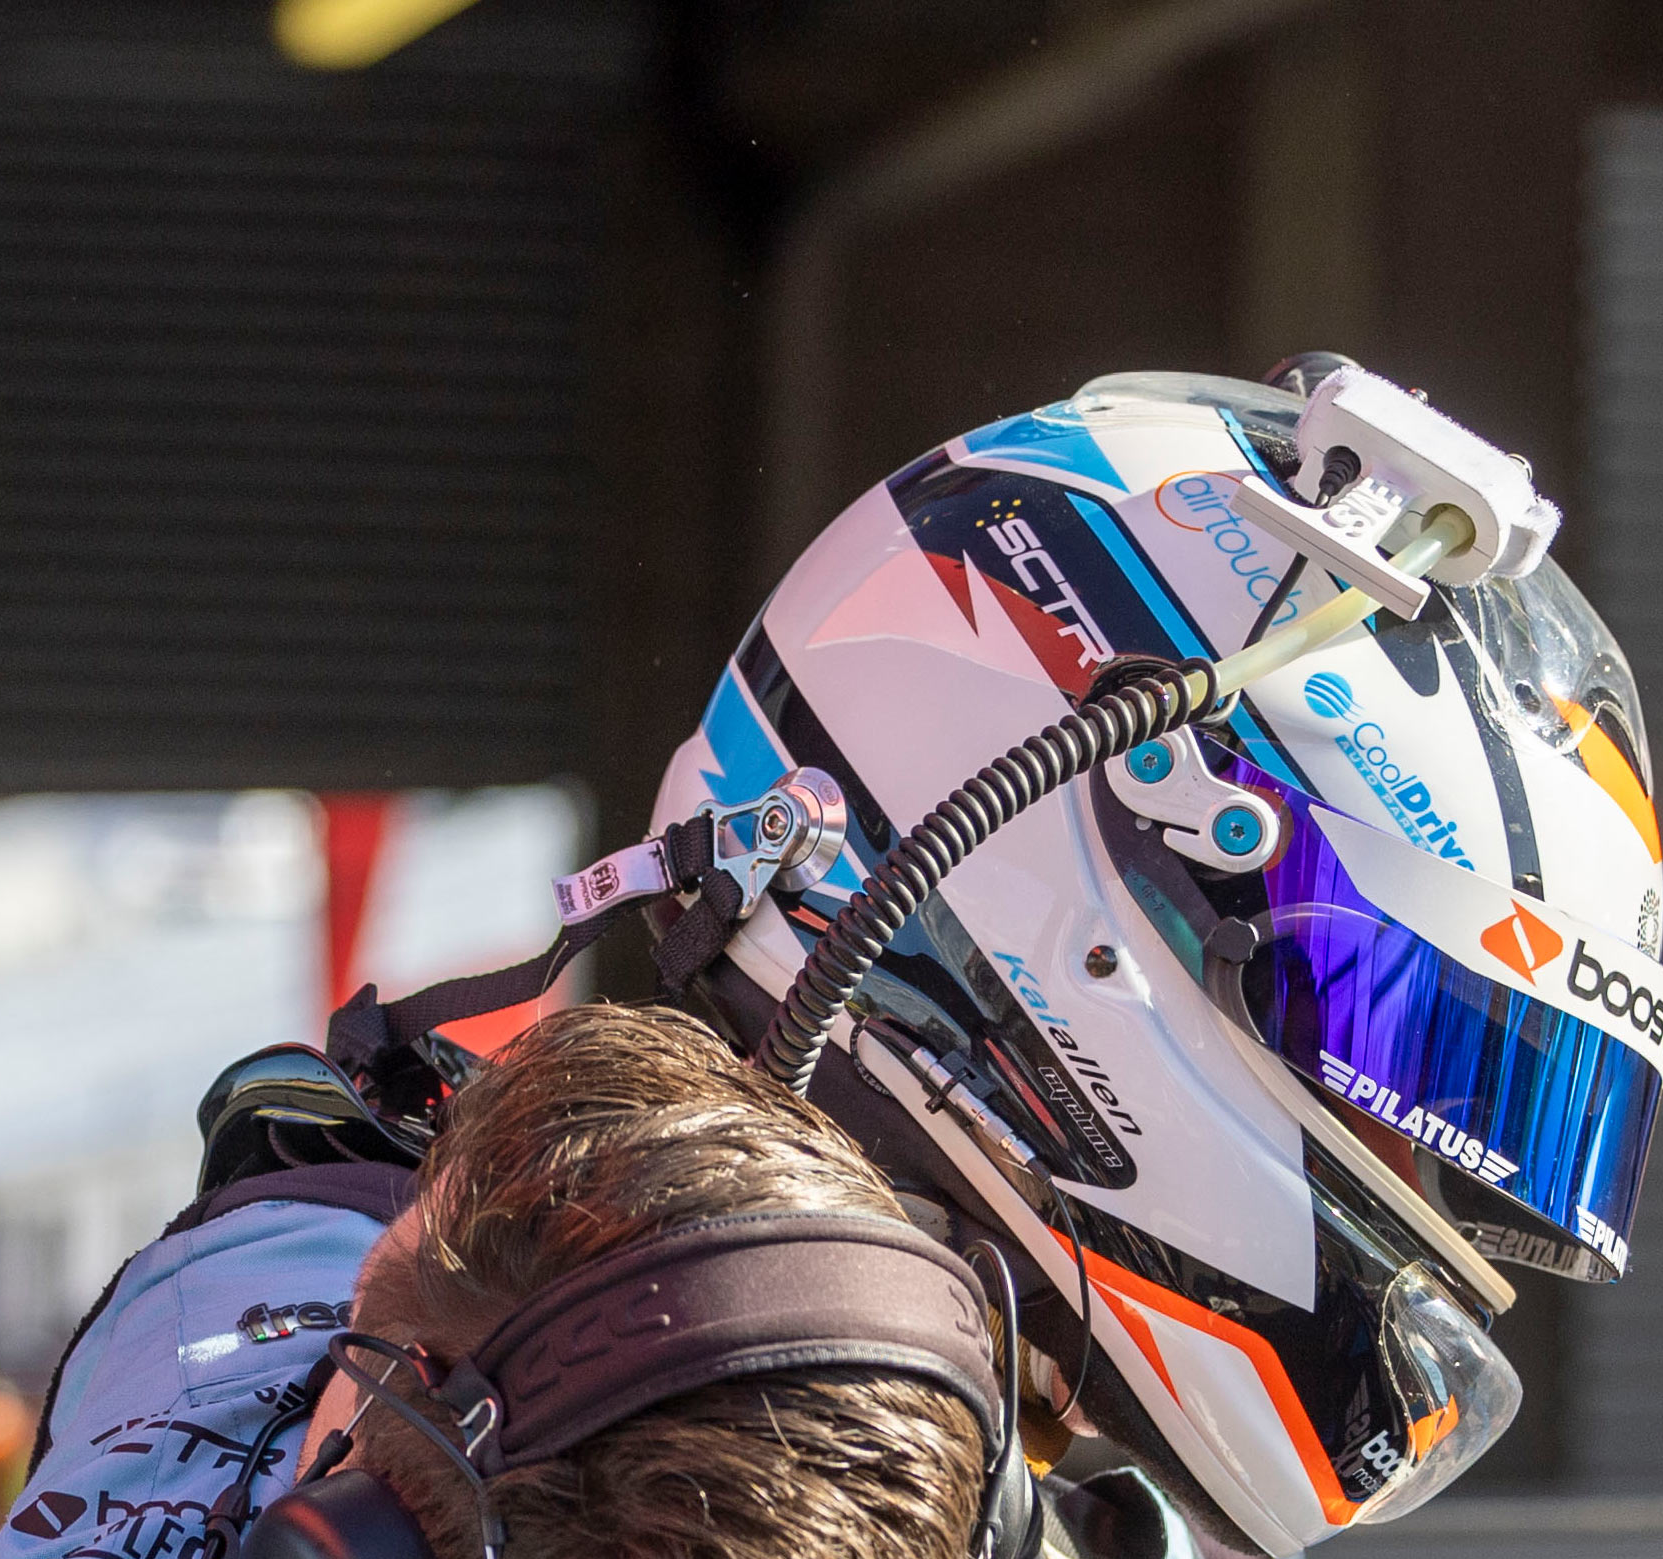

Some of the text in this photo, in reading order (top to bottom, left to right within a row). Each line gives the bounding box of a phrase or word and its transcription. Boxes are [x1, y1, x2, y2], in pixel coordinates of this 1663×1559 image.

[986, 518, 1115, 669] SCTR
[1175, 478, 1303, 627] airtouch
[1339, 740, 1431, 852] AUTO PARTS
[592, 863, 615, 898] FIA
[1038, 1066, 1123, 1168] cyclone
[1348, 1073, 1484, 1170] PILATUS
